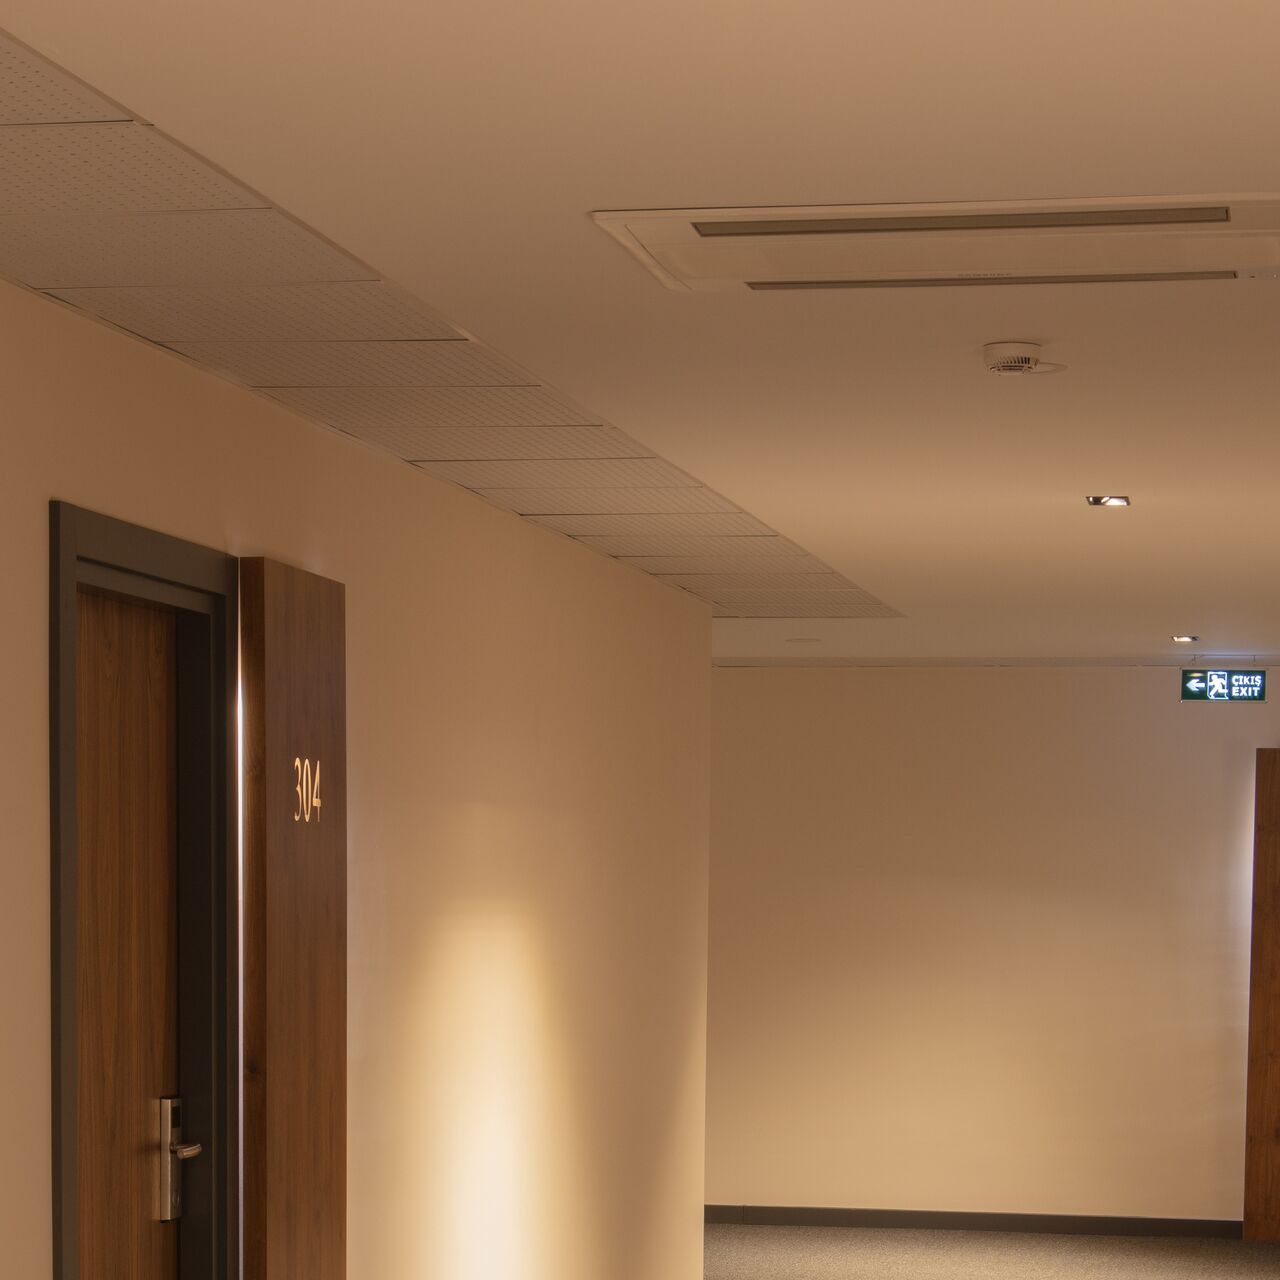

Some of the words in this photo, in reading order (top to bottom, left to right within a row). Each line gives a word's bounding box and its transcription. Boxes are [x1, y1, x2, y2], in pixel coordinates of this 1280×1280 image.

[1231, 675, 1262, 687] ÇIKIŞ
[1231, 687, 1261, 697] EXIT
[294, 757, 322, 823] 304
